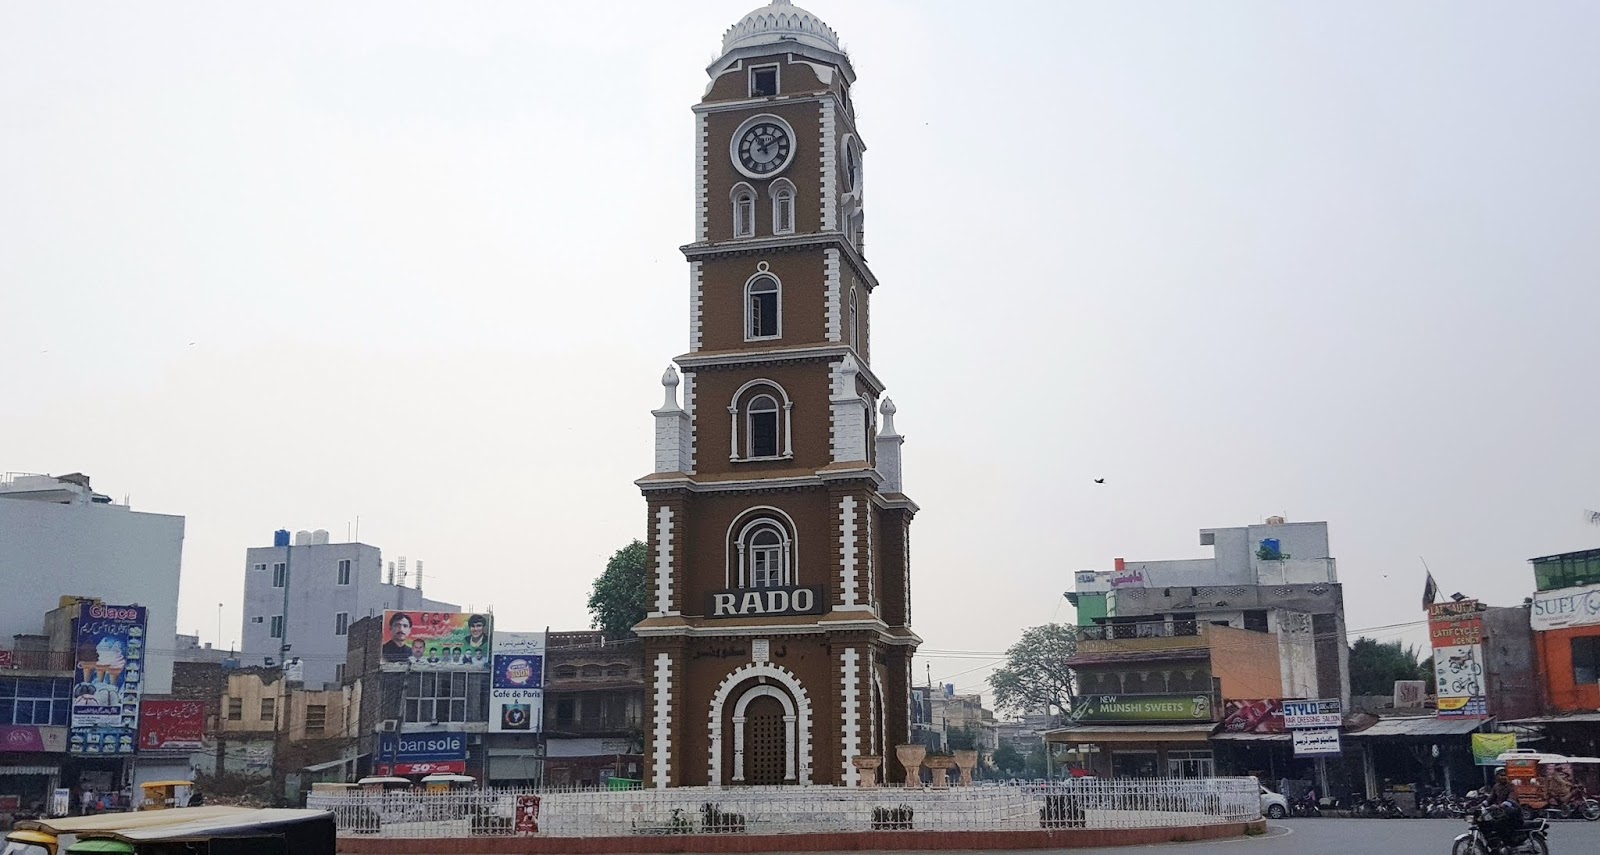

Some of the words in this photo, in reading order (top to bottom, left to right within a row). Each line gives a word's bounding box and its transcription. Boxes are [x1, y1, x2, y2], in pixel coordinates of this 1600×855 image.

[713, 588, 814, 616] RADO
[1535, 597, 1575, 616] SUFI
[89, 604, 137, 620] Glace
[1432, 628, 1454, 638] LATIF
[1454, 626, 1480, 636] CYCLE
[494, 690, 511, 698] Café
[512, 690, 522, 698] de
[523, 690, 541, 698] Paris
[1100, 703, 1142, 713] MUNSHI
[1145, 703, 1184, 712] SWEETS
[1284, 703, 1318, 716] STYLO
[1297, 716, 1320, 724] DRESSING
[383, 737, 461, 752] ubansole
